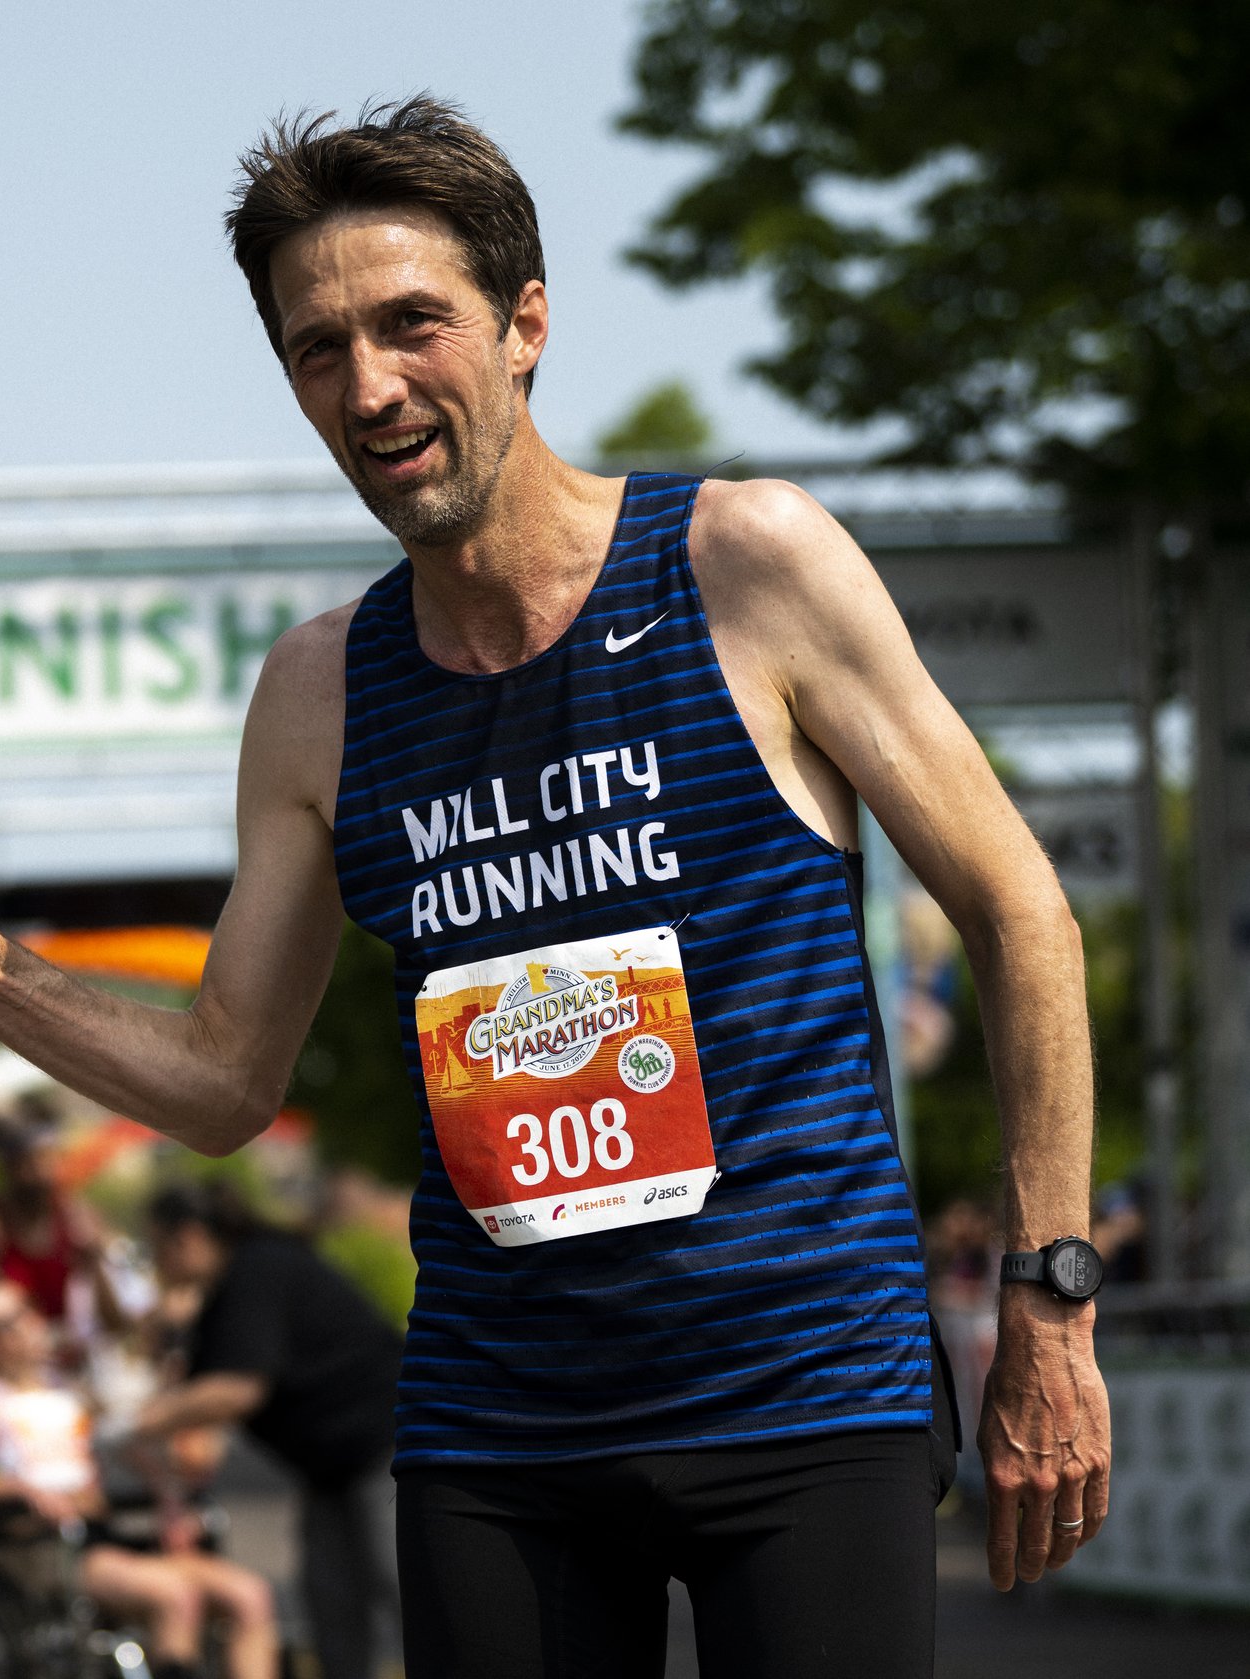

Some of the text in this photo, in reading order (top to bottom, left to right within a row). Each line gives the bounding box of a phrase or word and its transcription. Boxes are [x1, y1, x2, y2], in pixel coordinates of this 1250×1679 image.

[401, 740, 661, 864] MILL CITY
[411, 821, 681, 939] RUNNING
[470, 977, 615, 1053] GRANDMA'S
[506, 976, 528, 1002] DULUTH
[496, 998, 636, 1073] MARATHON
[571, 1050, 586, 1065] 2023
[505, 1097, 634, 1187] 308
[499, 1213, 536, 1228] TOYOTA
[575, 1195, 626, 1213] MEMBERS
